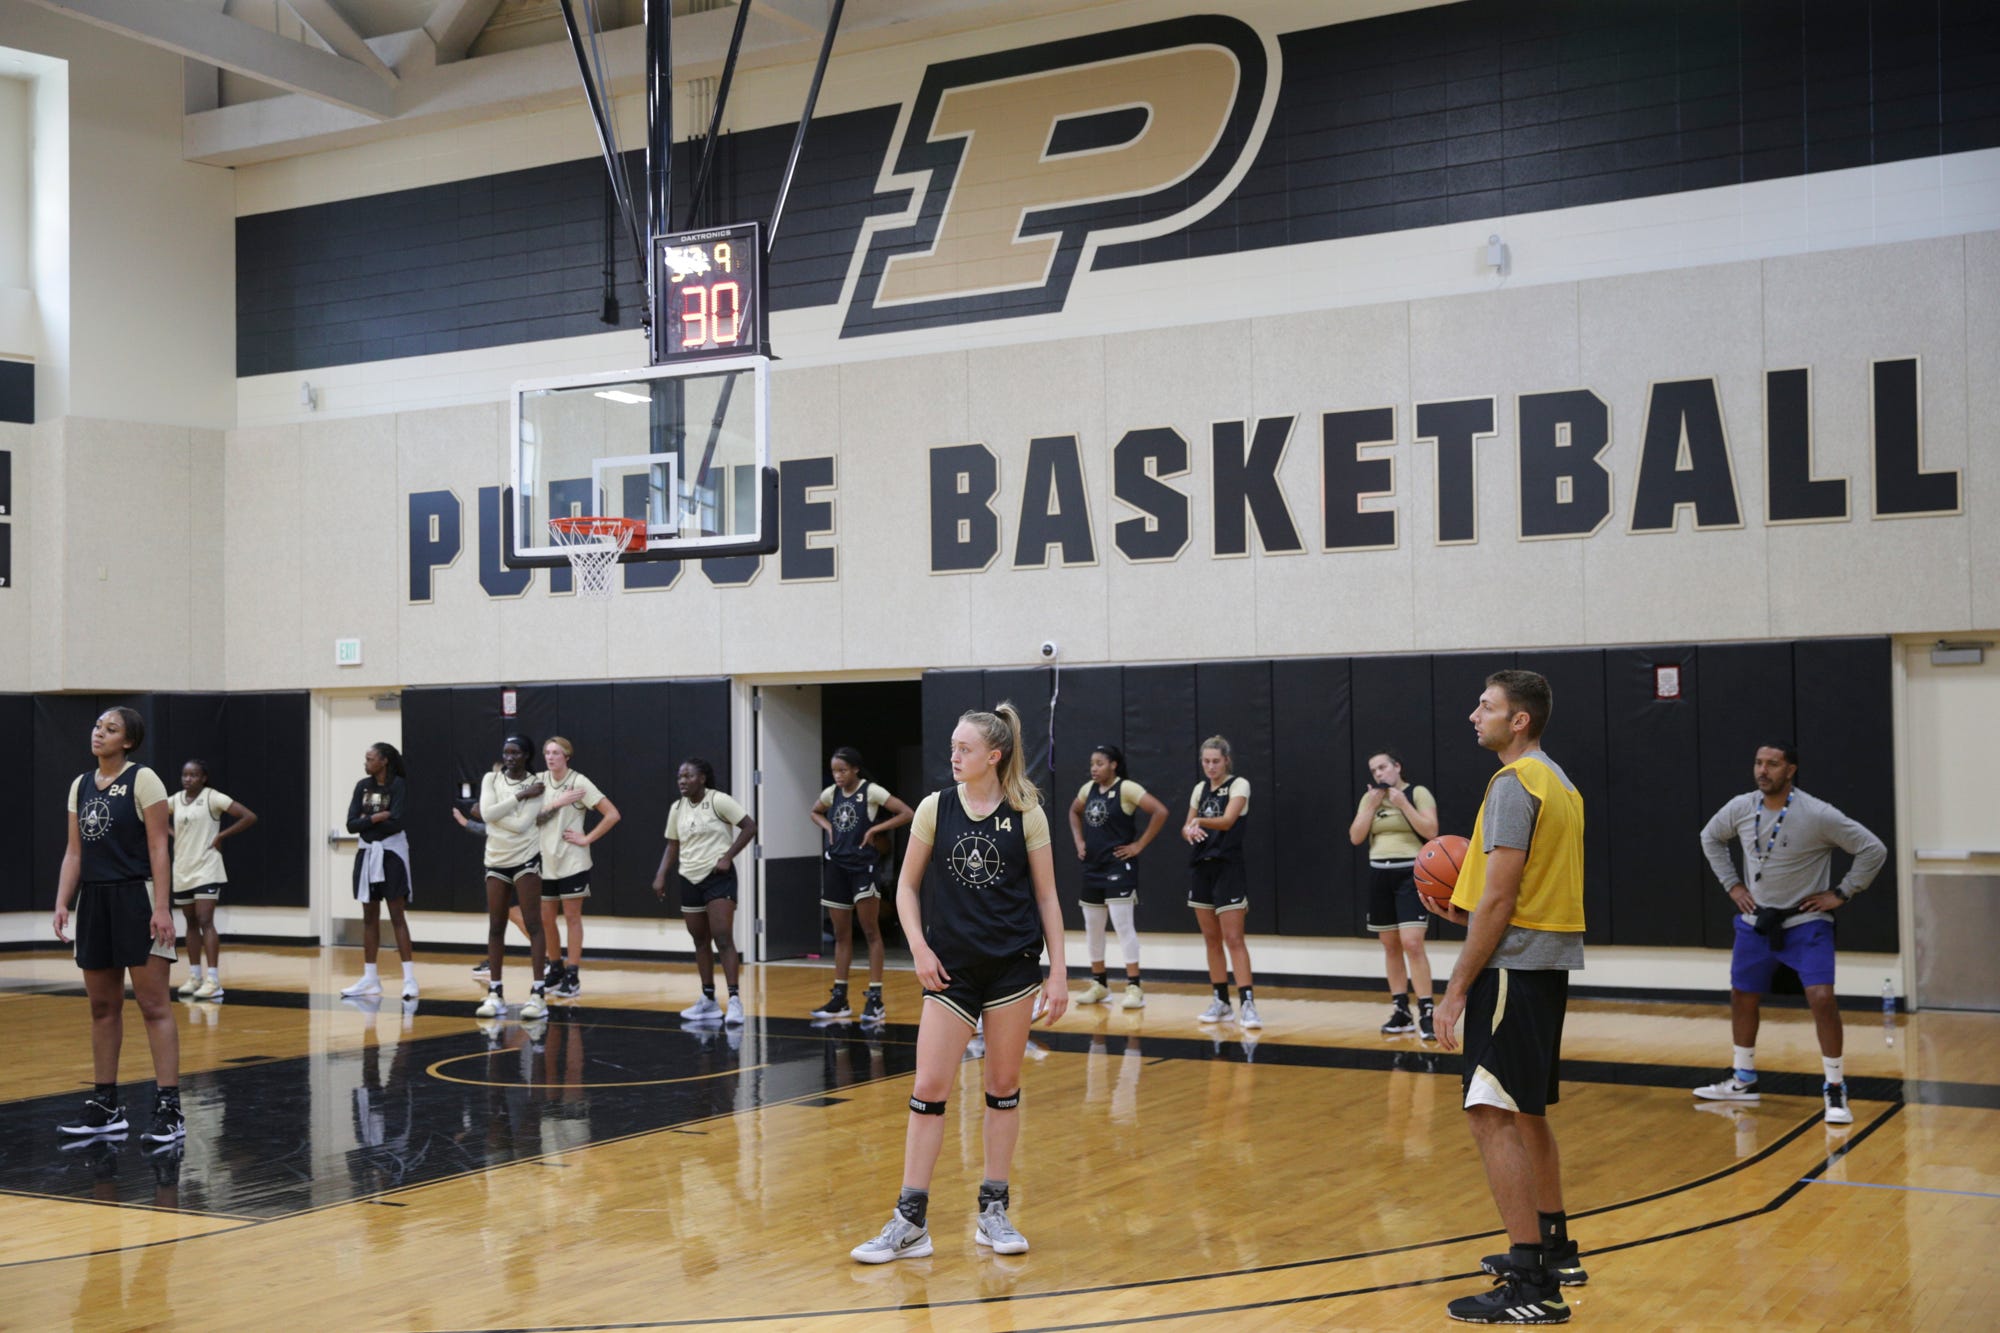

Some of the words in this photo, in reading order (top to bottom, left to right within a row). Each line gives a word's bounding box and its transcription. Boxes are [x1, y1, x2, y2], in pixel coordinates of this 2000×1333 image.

[681, 230, 731, 242] DAKTRONICS
[682, 281, 739, 347] 30
[928, 354, 1963, 574] BASKETBALL
[109, 784, 128, 797] 24
[856, 793, 864, 802] 3
[994, 816, 1012, 832] 14
